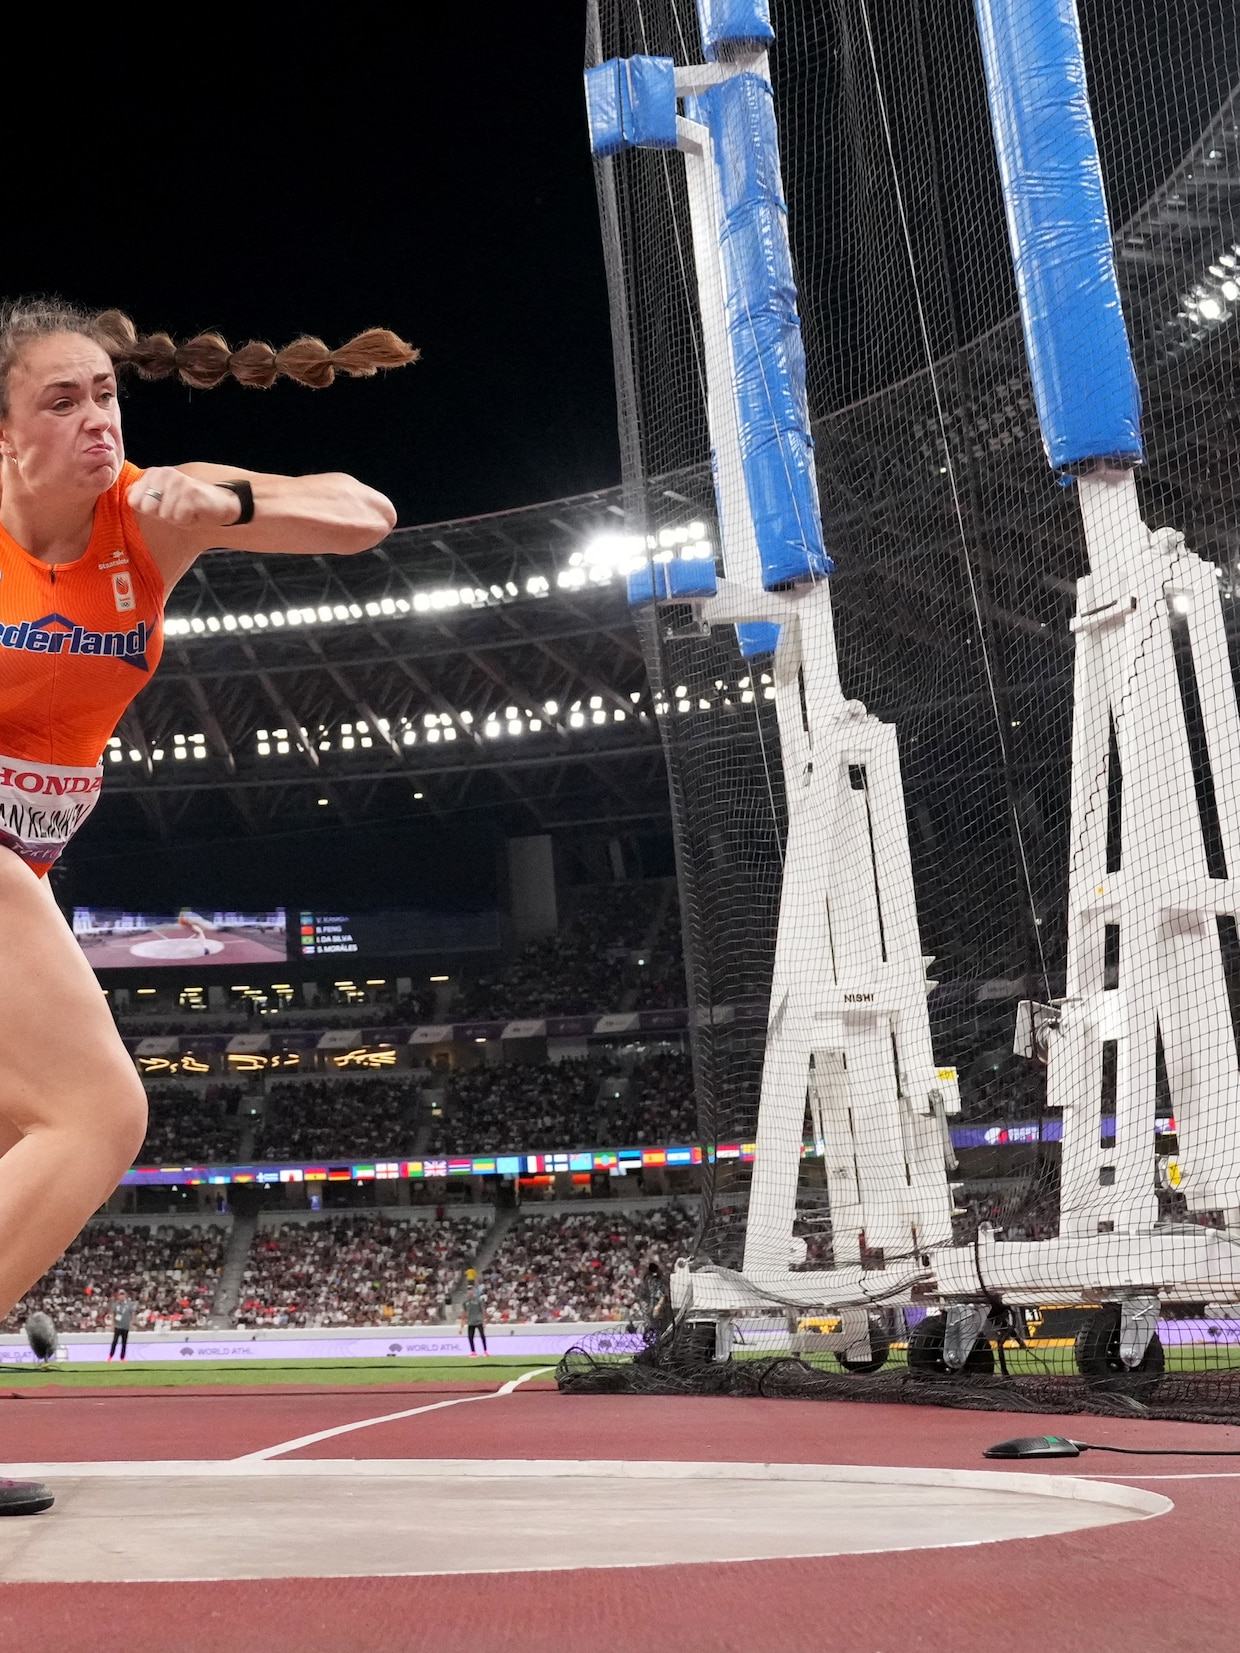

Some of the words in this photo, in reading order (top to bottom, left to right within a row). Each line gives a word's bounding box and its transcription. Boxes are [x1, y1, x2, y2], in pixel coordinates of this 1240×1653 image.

[844, 993, 874, 1002] NISHI
[197, 1347, 230, 1355] WORLD
[406, 1344, 439, 1352] WORLD
